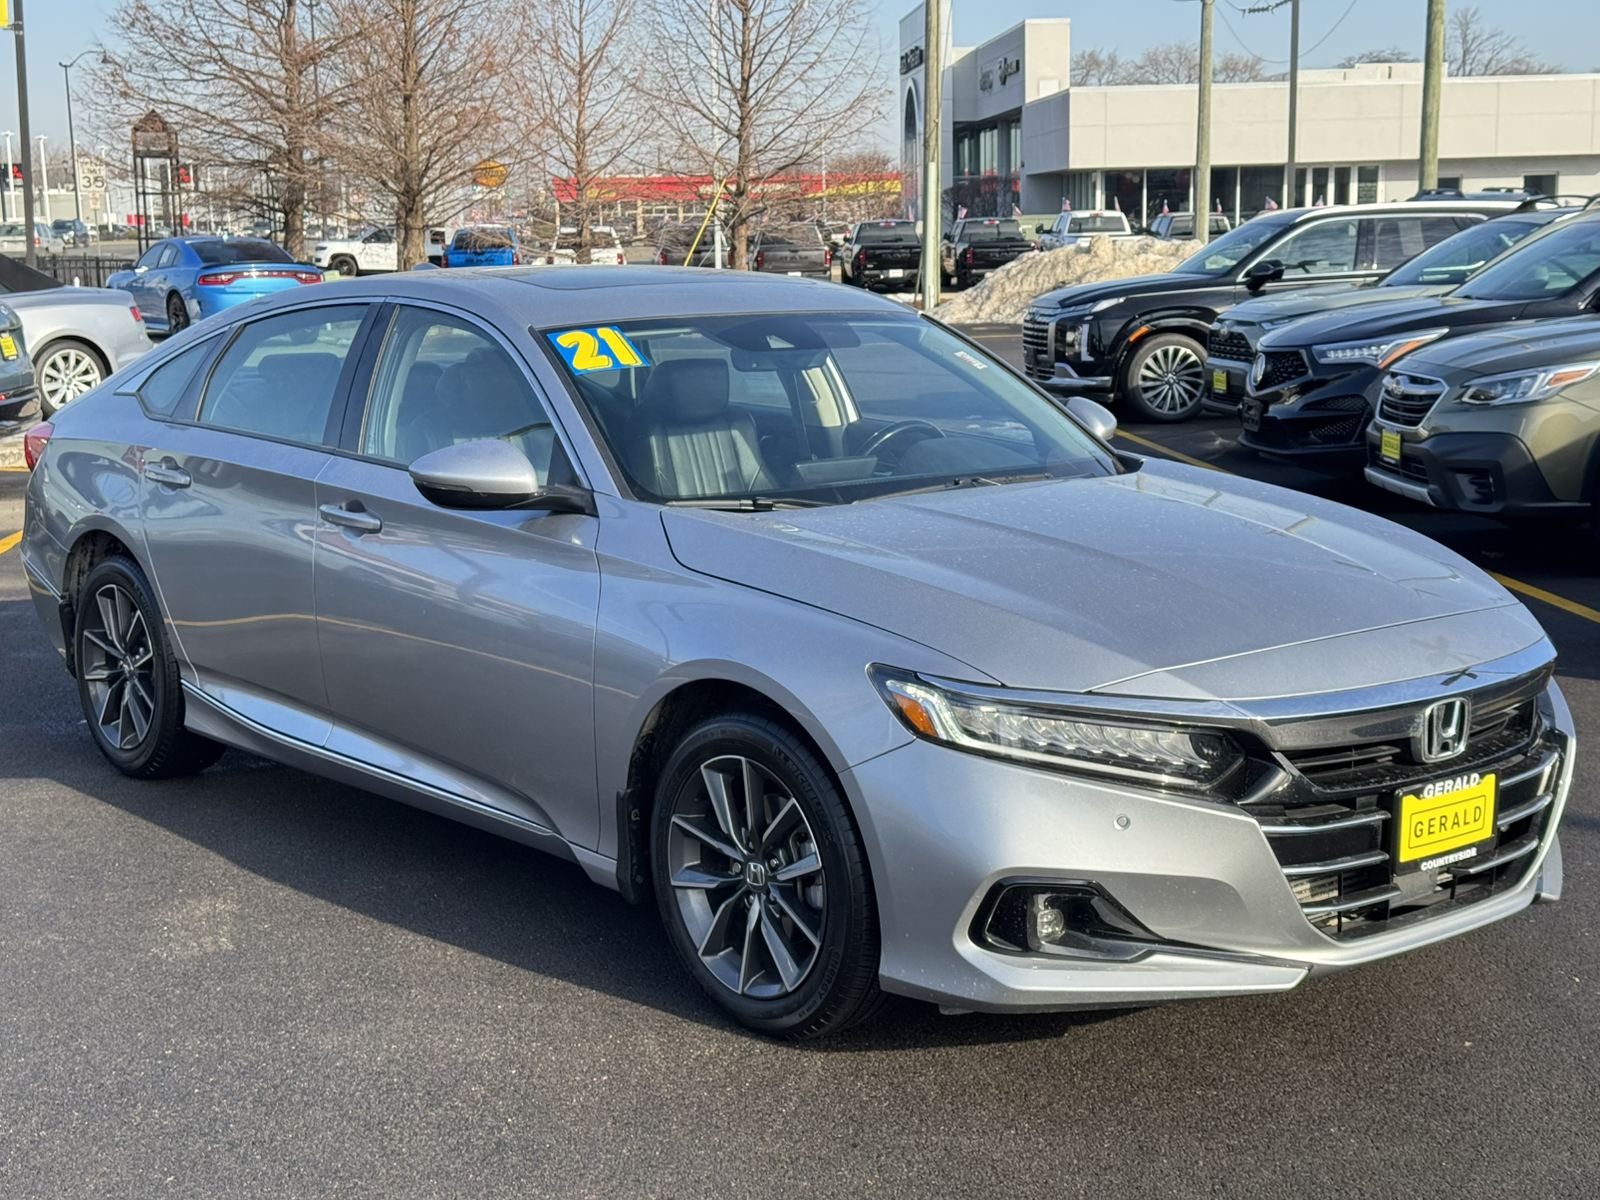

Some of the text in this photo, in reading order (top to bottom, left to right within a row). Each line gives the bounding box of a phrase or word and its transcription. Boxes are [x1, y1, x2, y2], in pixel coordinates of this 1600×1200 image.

[82, 176, 105, 188] 35
[556, 327, 643, 371] 21
[786, 761, 828, 824] MICHELIN
[1423, 773, 1480, 799] GERALD
[1413, 806, 1482, 838] GERALD
[1421, 847, 1477, 871] COUNTRYSIDE
[816, 951, 841, 1000] ENERGY
